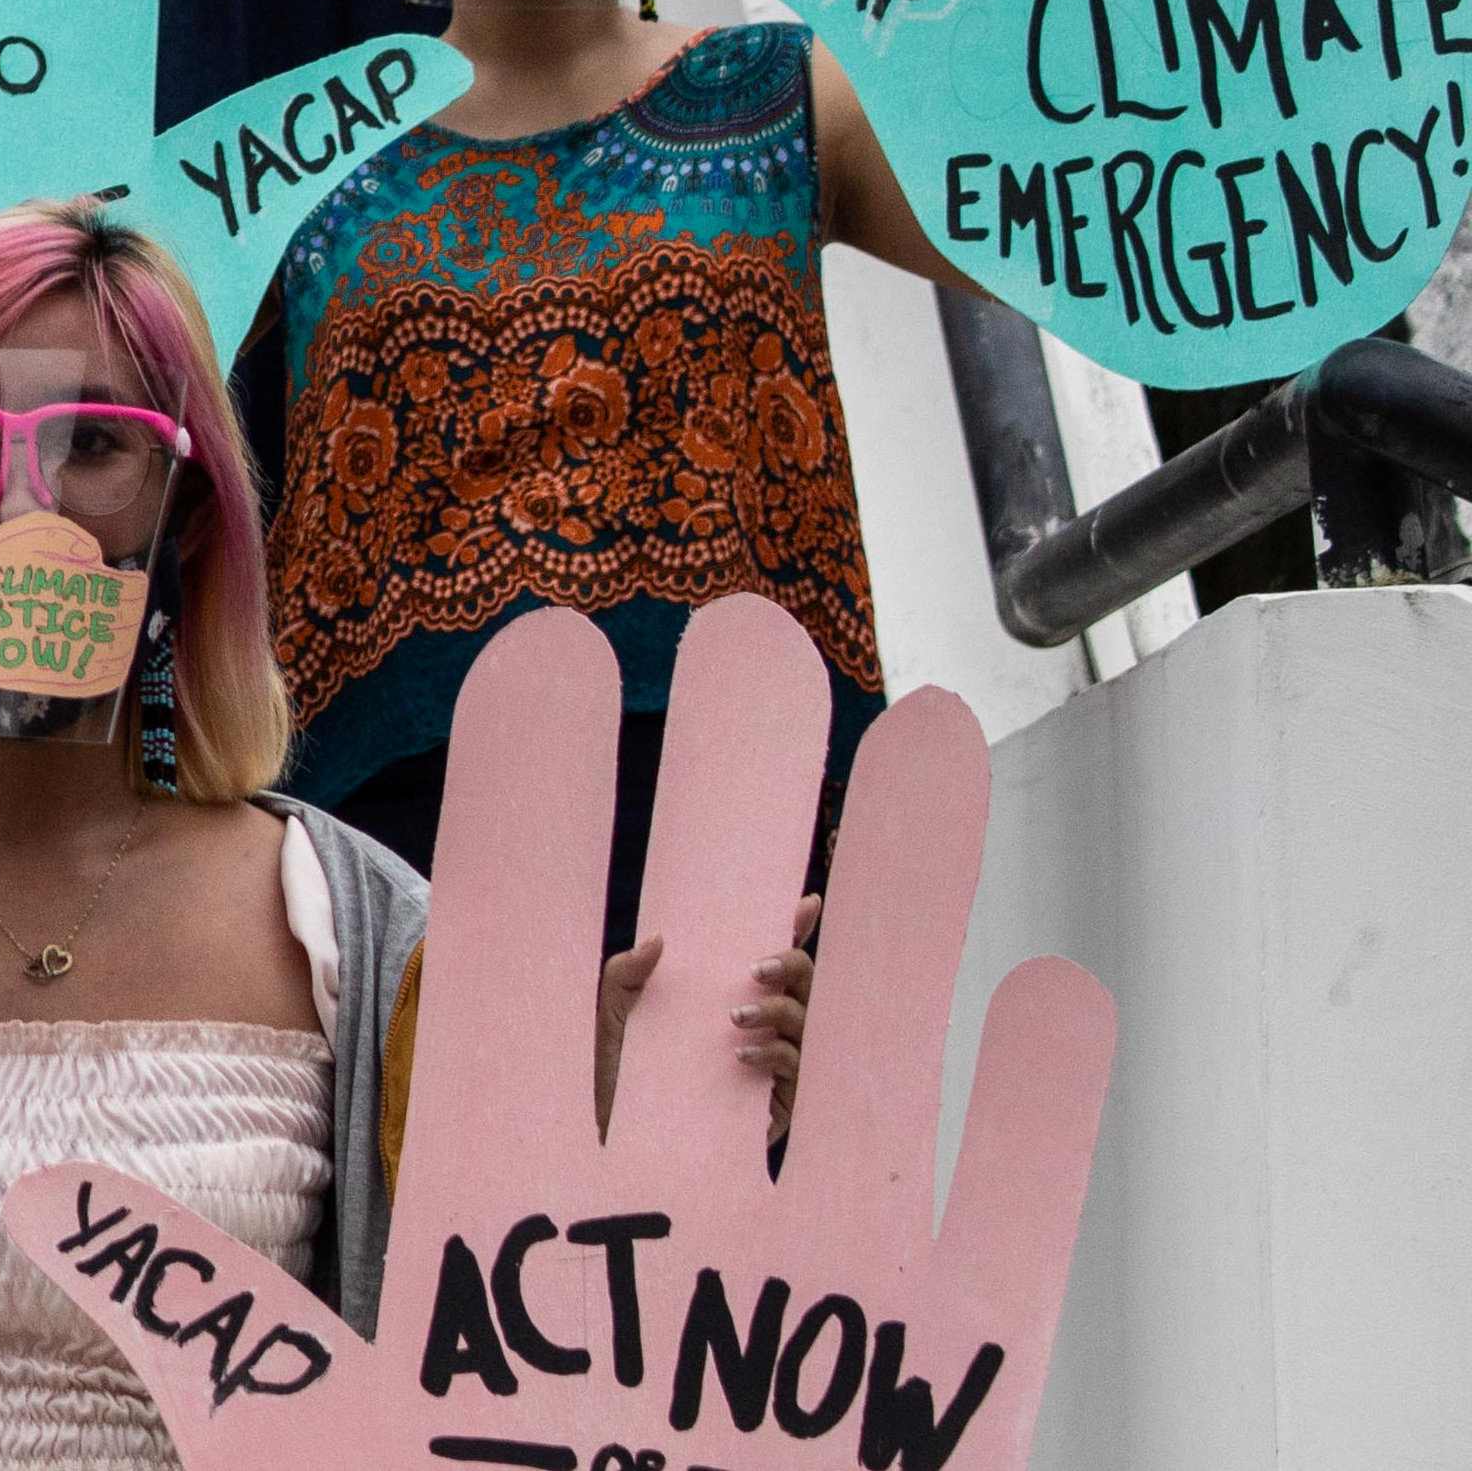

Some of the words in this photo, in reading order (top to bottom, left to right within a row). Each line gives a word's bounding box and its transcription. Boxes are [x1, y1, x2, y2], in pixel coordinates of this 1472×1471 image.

[179, 49, 417, 237] YACAP
[947, 81, 1469, 336] EMERGENCY!
[56, 1181, 333, 1412] YACAP
[420, 1213, 671, 1396] ACT
[668, 1269, 1006, 1471] NOW
